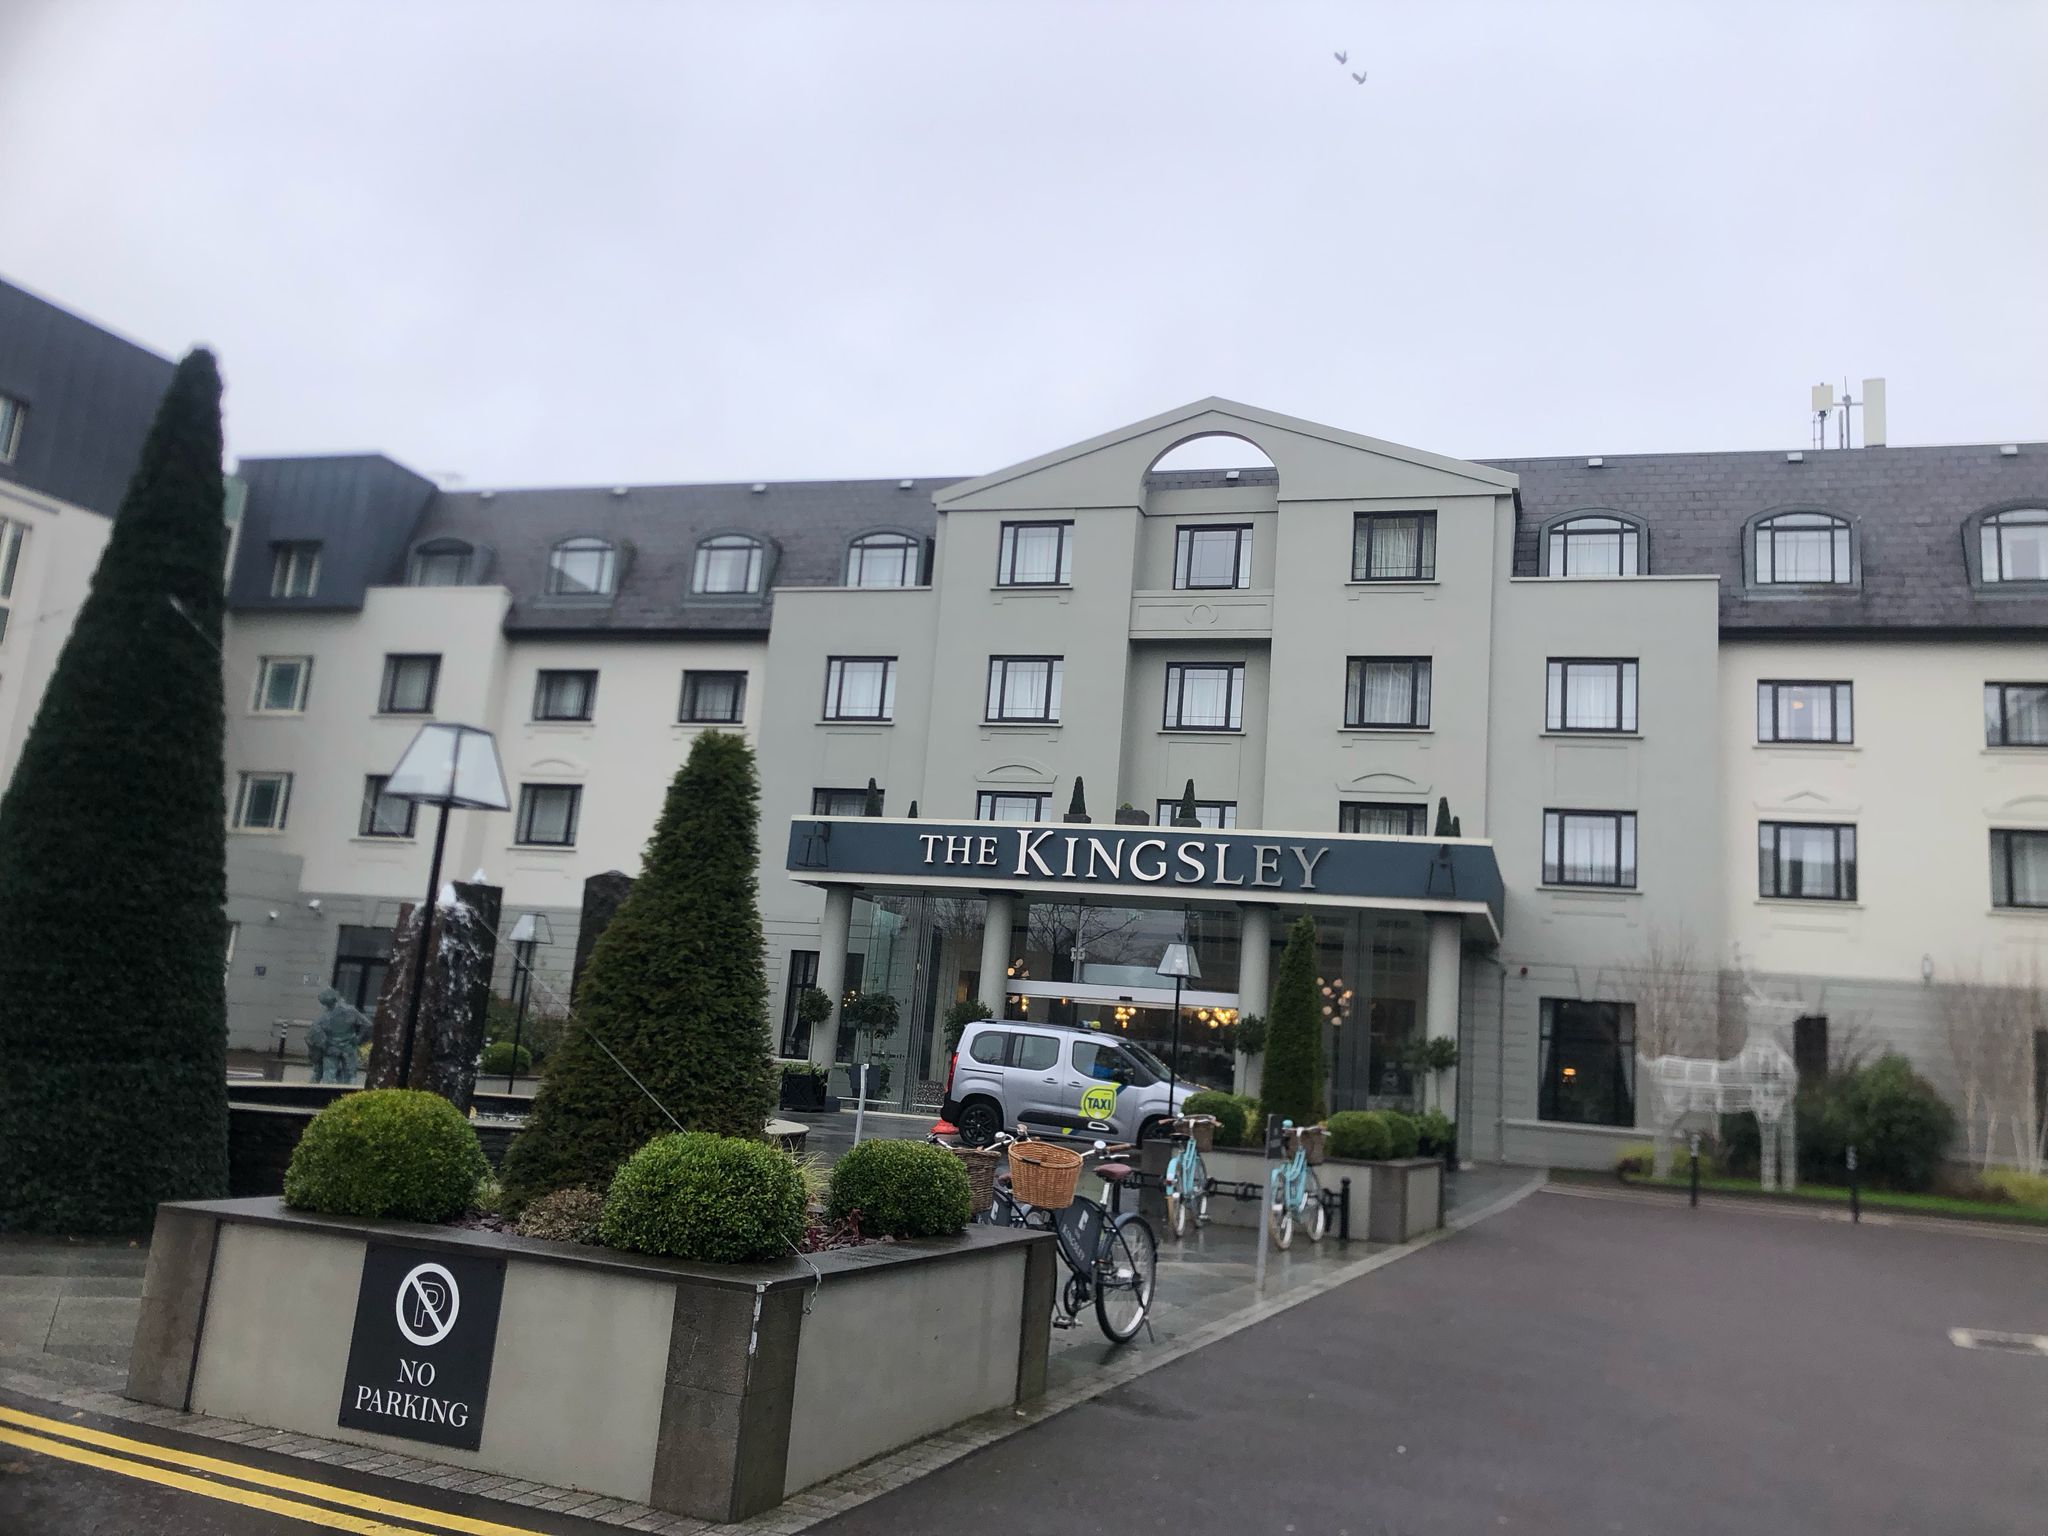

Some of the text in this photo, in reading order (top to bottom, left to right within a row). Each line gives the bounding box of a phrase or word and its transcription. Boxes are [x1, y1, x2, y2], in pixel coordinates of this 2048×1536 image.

[918, 828, 1331, 890] THE KINGSLEY
[1087, 1096, 1112, 1111] TAXI
[396, 1357, 436, 1387] NO
[354, 1384, 469, 1428] PARKING
